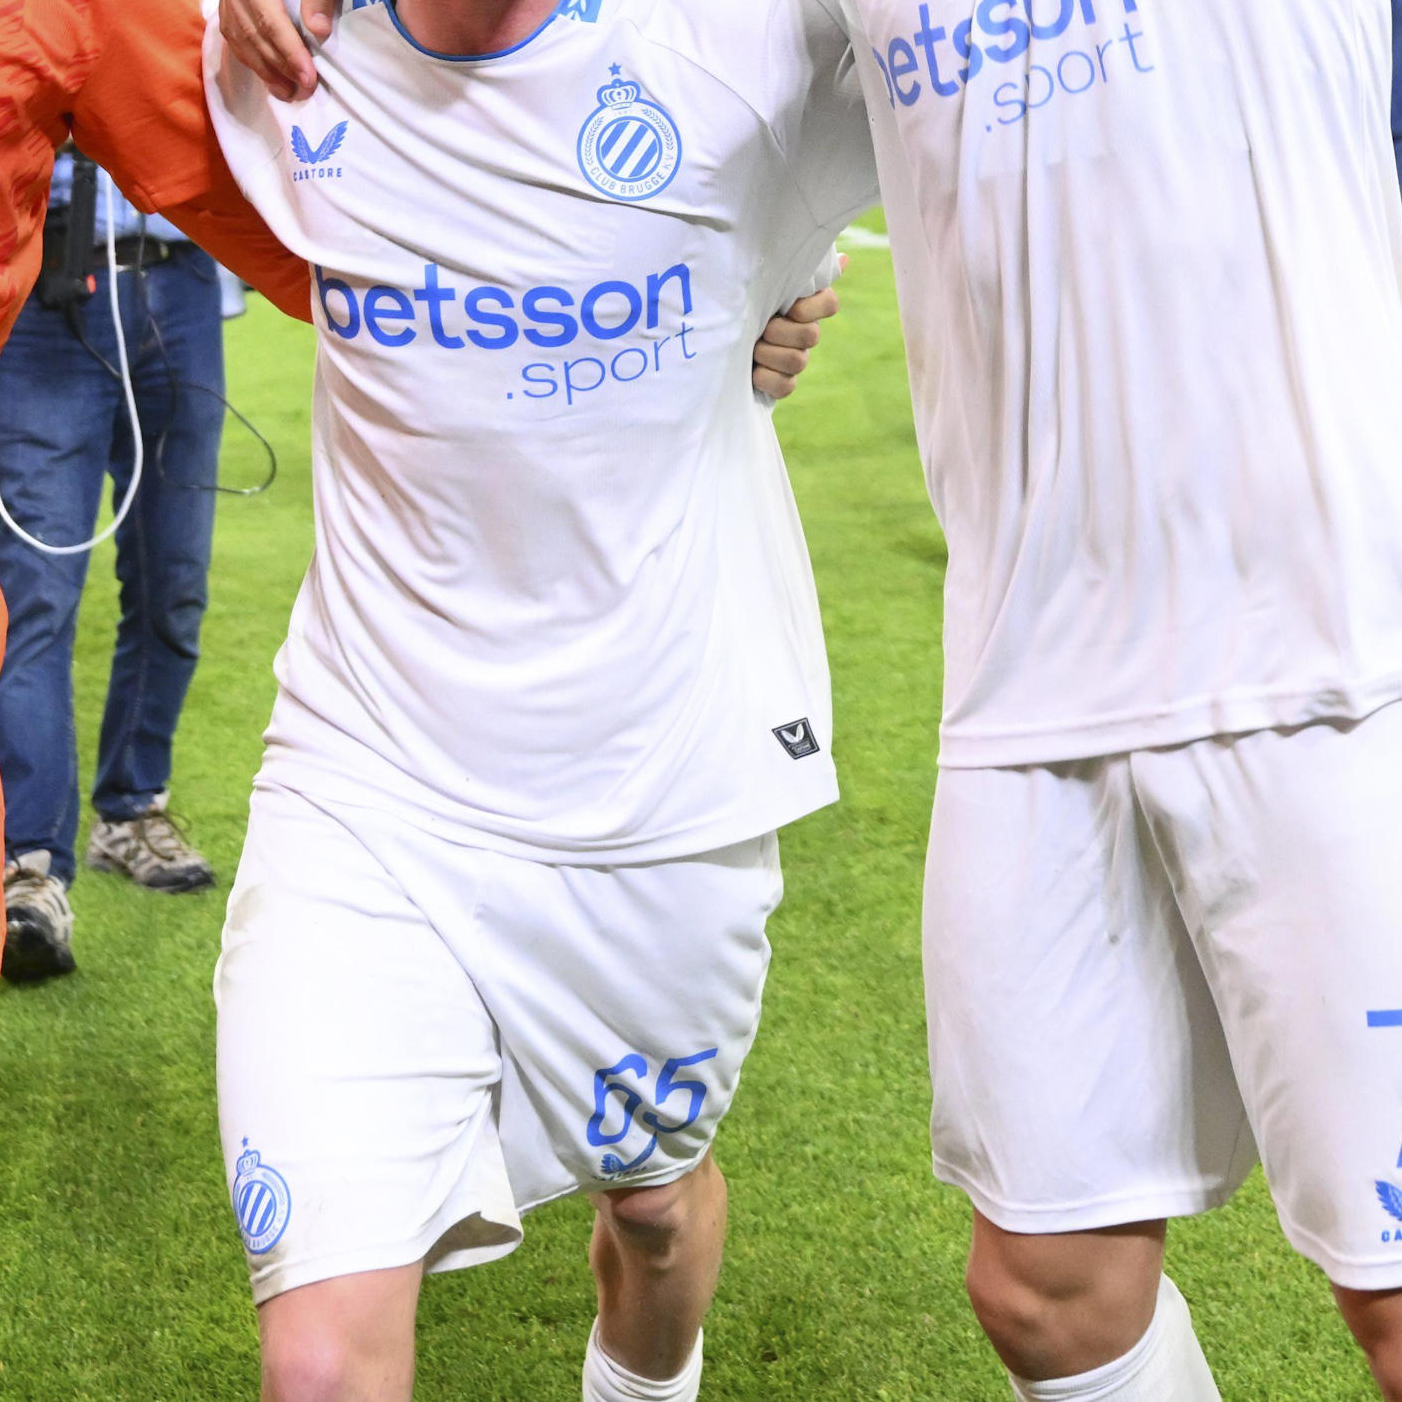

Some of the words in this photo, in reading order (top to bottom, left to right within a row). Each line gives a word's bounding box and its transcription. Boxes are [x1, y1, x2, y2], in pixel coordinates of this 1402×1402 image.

[293, 166, 343, 182] CASTORE
[591, 166, 616, 190] CLUB
[620, 171, 666, 195] BRUGGE
[315, 263, 692, 350] betsson
[506, 321, 699, 405] .sport
[586, 1047, 718, 1147] 65
